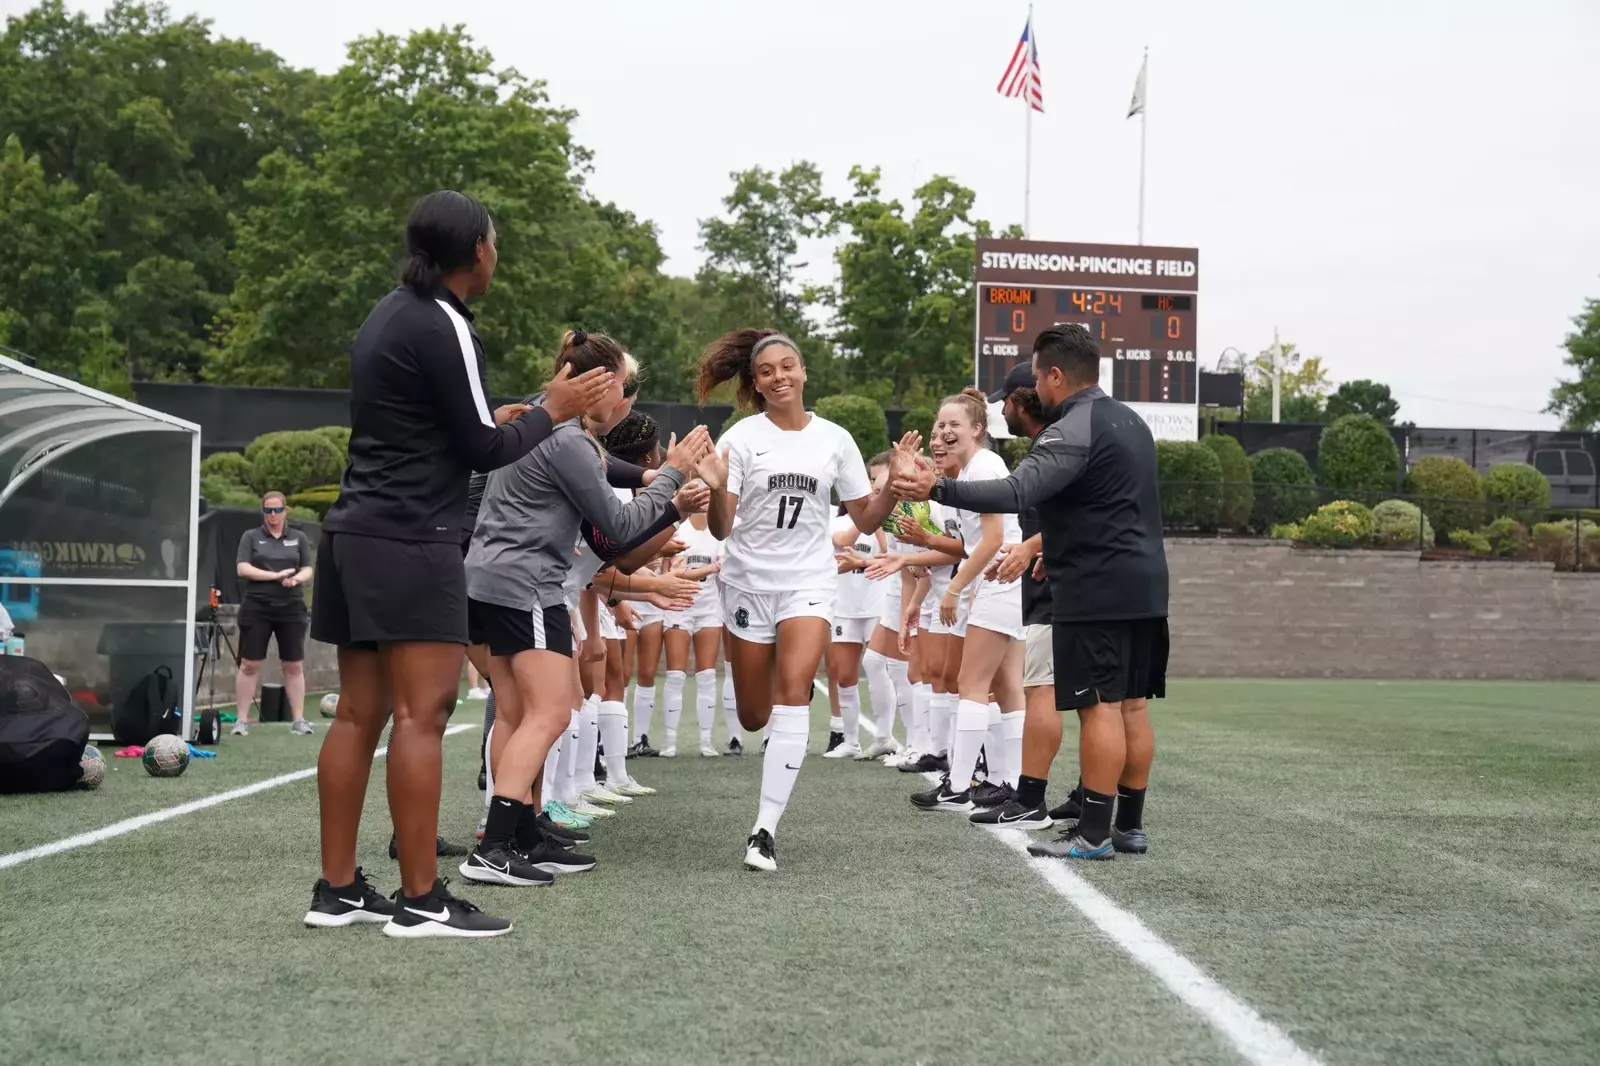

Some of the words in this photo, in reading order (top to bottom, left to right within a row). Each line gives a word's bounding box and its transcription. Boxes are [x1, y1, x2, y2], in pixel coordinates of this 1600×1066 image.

[982, 251, 1152, 276] STEVENSON-PINCINCE
[1156, 259, 1196, 277] FIELD
[990, 287, 1031, 305] BROWN
[1072, 292, 1122, 314] 4:24
[1158, 296, 1173, 310] HC
[1012, 309, 1026, 333] 0
[1168, 316, 1180, 339] 0
[983, 344, 992, 355] C.
[993, 344, 1019, 357] KICKS
[1116, 349, 1125, 360] C.
[1126, 349, 1151, 361] KICKS
[1167, 350, 1196, 362] S.O.G.
[768, 472, 818, 495] BROWN
[777, 496, 804, 529] 17
